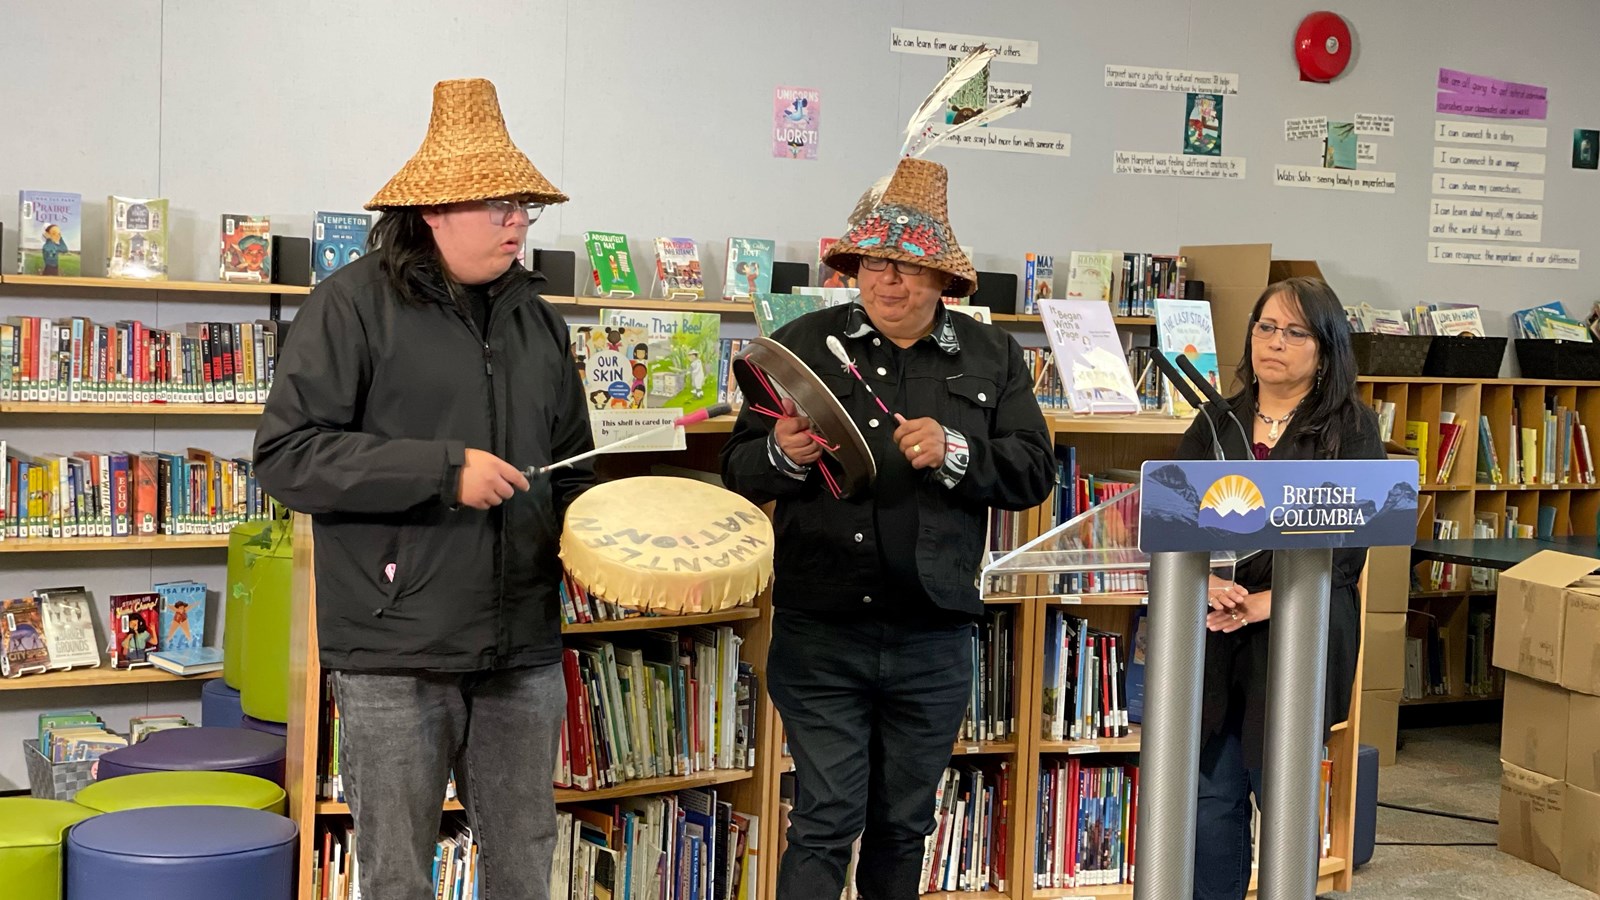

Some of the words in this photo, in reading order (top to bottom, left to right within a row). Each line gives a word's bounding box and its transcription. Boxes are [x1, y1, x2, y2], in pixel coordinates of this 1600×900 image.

[892, 33, 902, 46] We
[916, 36, 932, 48] learn
[933, 38, 947, 50] from
[776, 88, 820, 103] UNICORNS
[776, 128, 818, 145] WORST!
[1448, 129, 1459, 137] can
[1462, 129, 1482, 138] connect
[1449, 156, 1461, 164] can
[1448, 182, 1459, 190] can
[31, 200, 72, 215] PRAIRIE
[35, 210, 68, 223] LOTUS
[323, 216, 367, 226] TEMPLETON
[1432, 224, 1445, 234] and
[1448, 223, 1458, 234] the
[591, 233, 625, 243] ABSOLUTELY
[1037, 255, 1054, 268] MAX
[1049, 305, 1057, 315] It
[1057, 311, 1083, 322] Began
[1174, 311, 1188, 326] LAST
[1191, 312, 1211, 334] STRAW
[652, 317, 678, 333] That
[682, 319, 702, 334] Bee!
[1053, 320, 1074, 330] With
[1060, 330, 1080, 341] Page
[223, 352, 232, 375] ALLIES
[597, 356, 619, 368] OUR
[593, 368, 624, 382] SKIN
[602, 420, 616, 428] This
[601, 429, 609, 437] by
[118, 477, 127, 508] ECHO
[1283, 485, 1356, 505] BRITISH
[1270, 507, 1366, 527] COLUMBIA
[181, 586, 206, 594] FIPPS
[56, 640, 90, 653] GROUNDS
[8, 651, 27, 661] CITY
